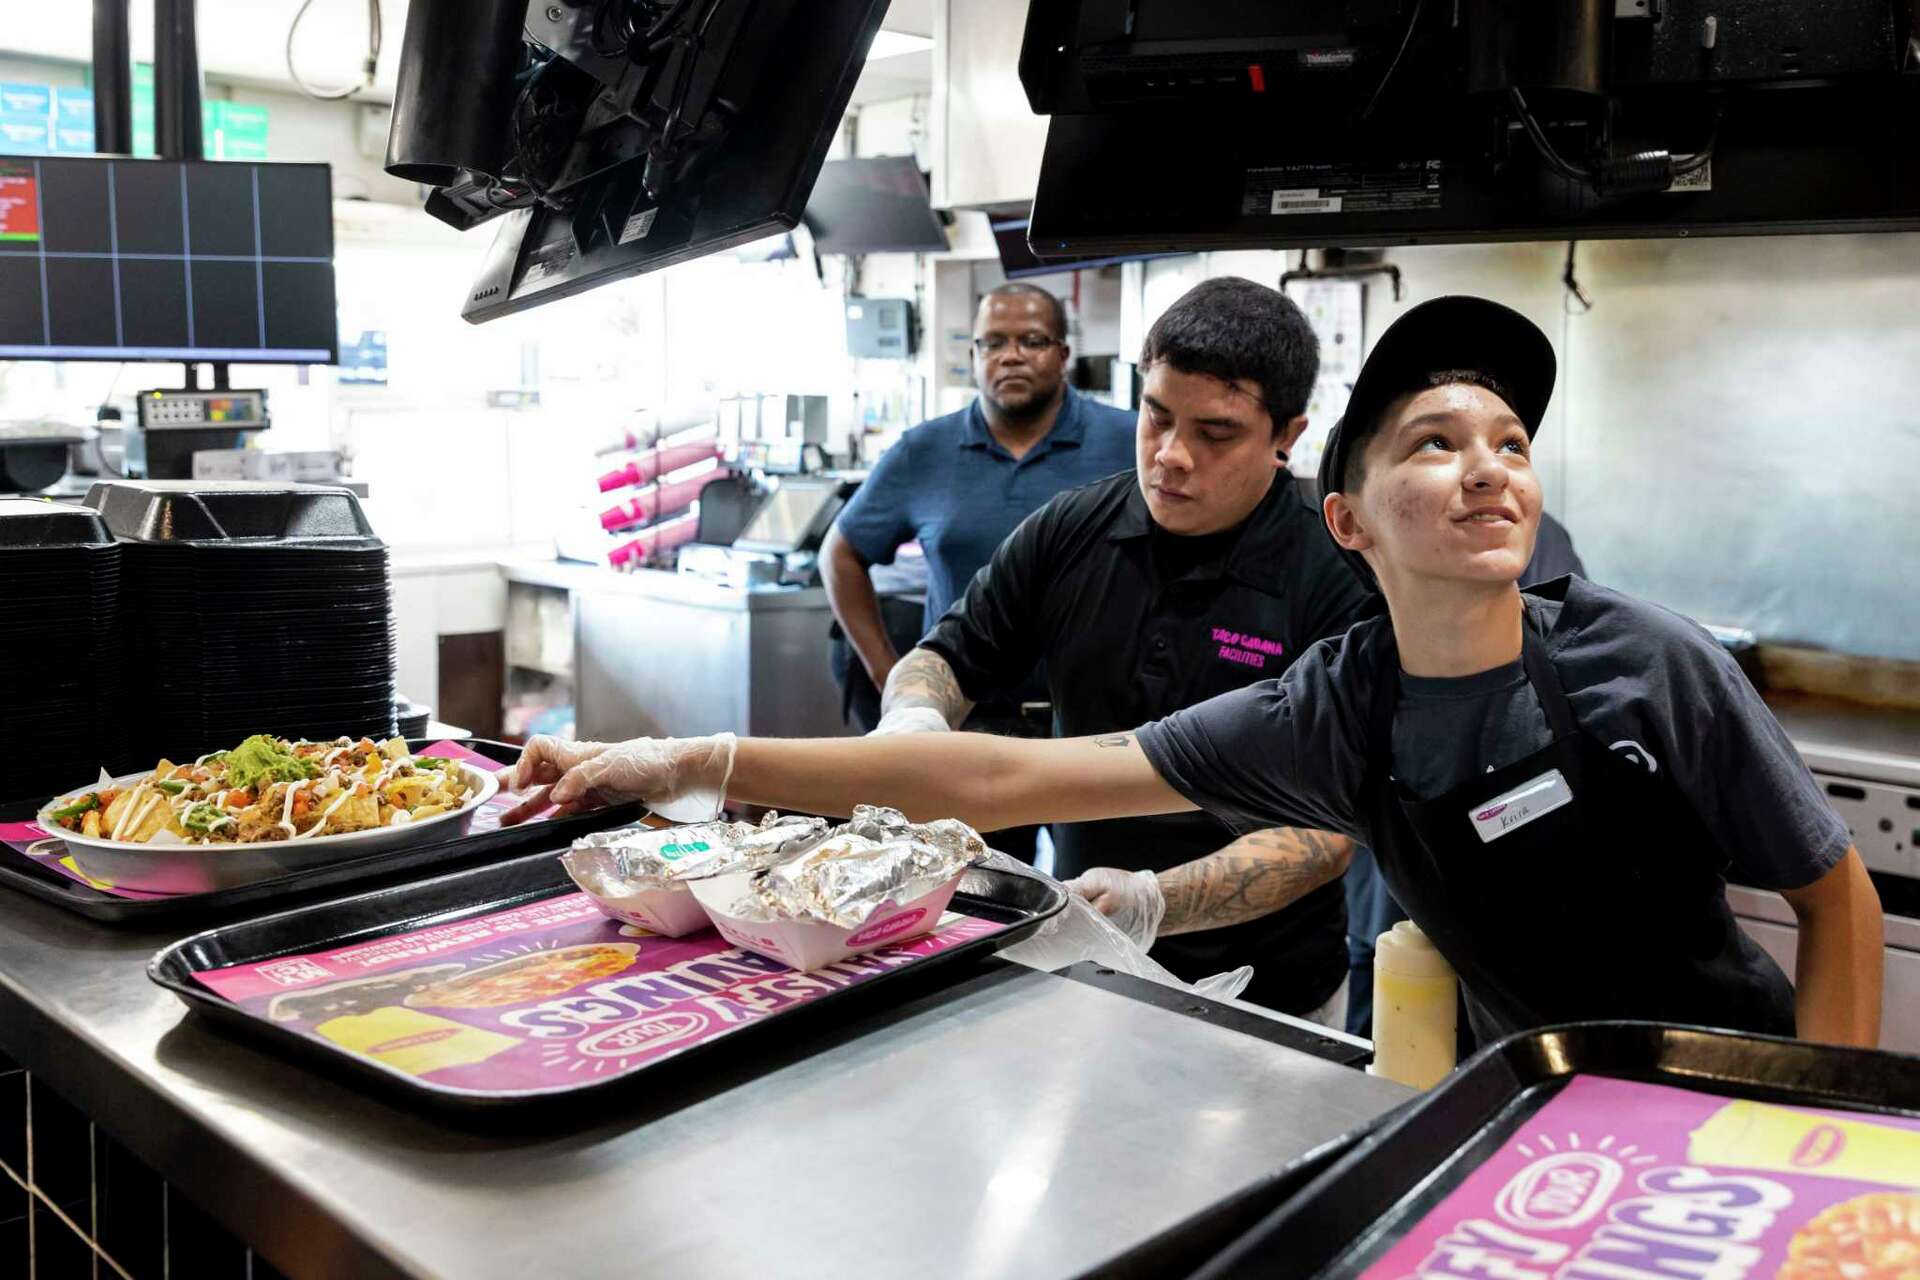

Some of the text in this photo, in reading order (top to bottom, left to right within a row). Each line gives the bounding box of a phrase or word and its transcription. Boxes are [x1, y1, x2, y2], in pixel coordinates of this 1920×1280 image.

[1212, 628, 1283, 656] TACO CABANA
[1218, 645, 1265, 668] FACILITIES
[359, 927, 494, 967] REWARD!
[501, 948, 796, 1038] AVINGS
[605, 1018, 683, 1047] YOUR
